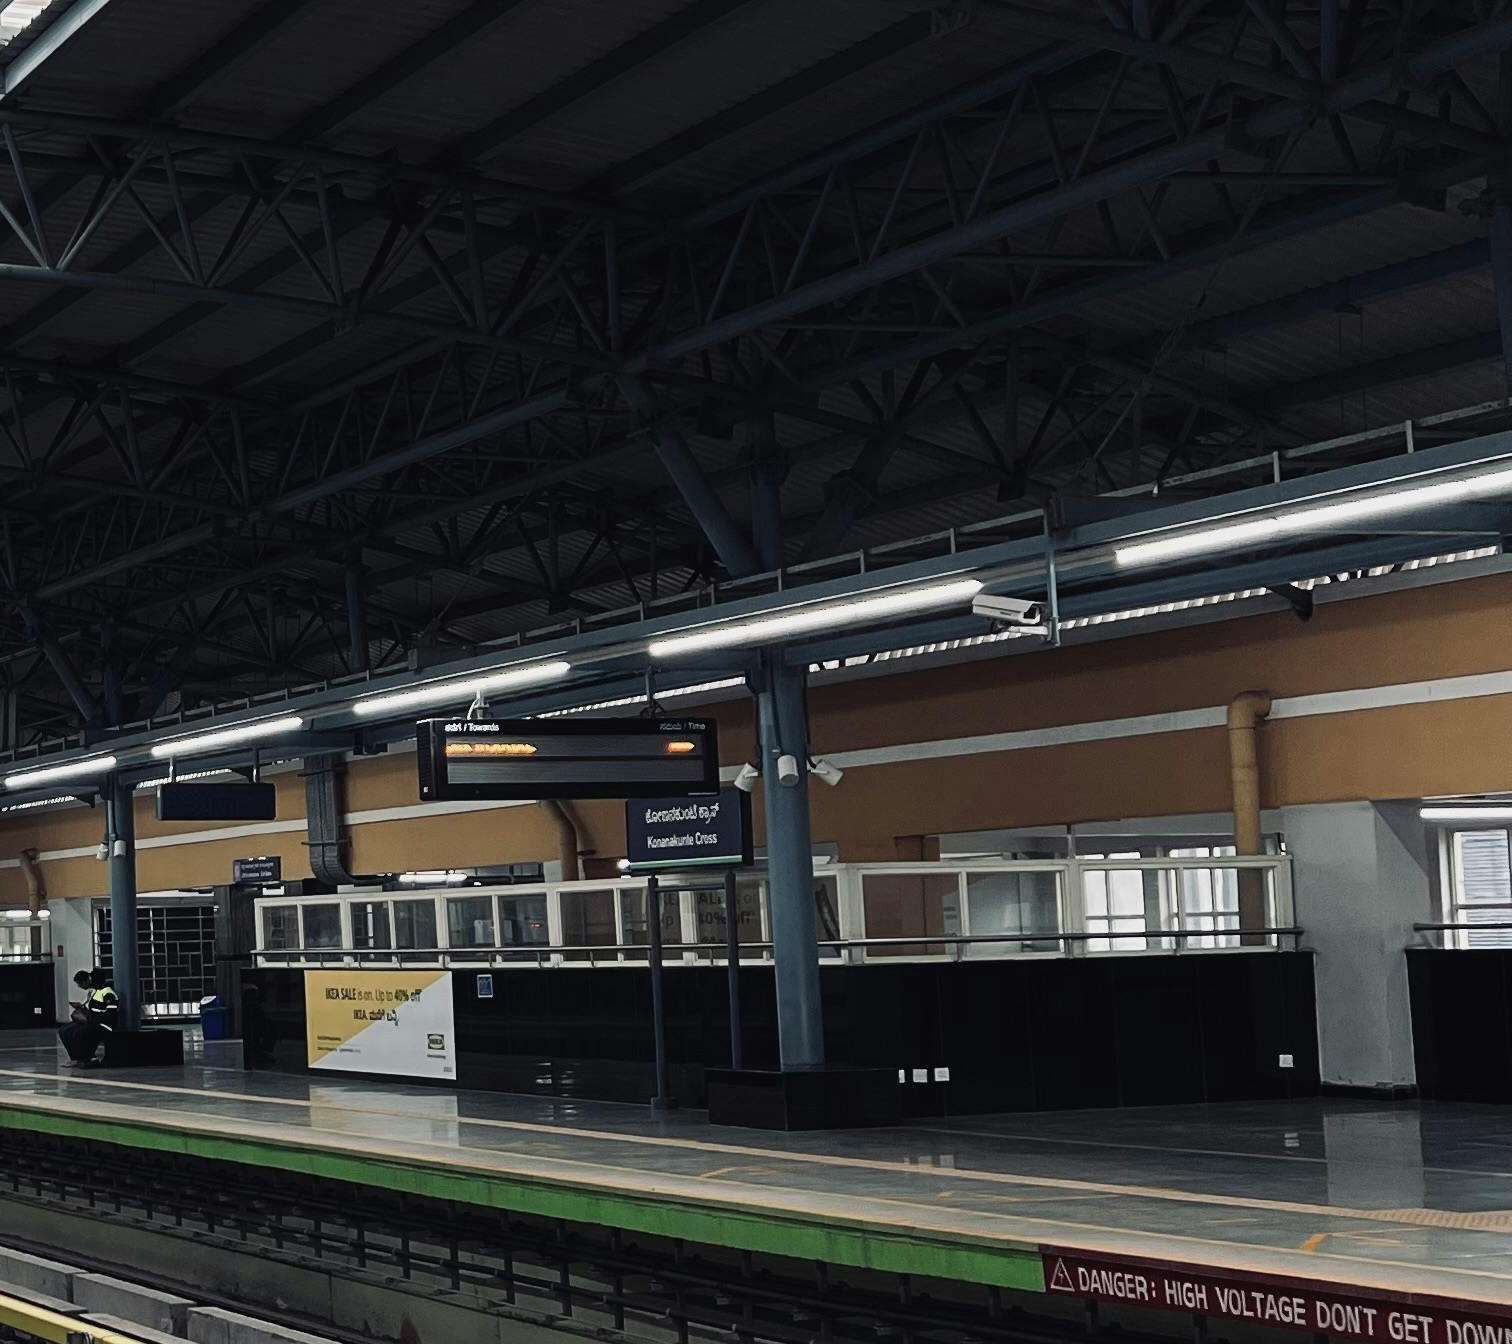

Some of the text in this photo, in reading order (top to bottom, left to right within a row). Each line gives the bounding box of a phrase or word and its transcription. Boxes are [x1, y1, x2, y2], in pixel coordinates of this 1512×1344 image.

[688, 722, 706, 731] Time
[695, 831, 718, 845] Cross
[325, 988, 339, 1000] IKEA
[341, 988, 357, 1001] SALE
[375, 989, 385, 1004] Up
[386, 991, 393, 1002] to
[394, 988, 409, 1002] 40%
[410, 988, 423, 1002] off
[1164, 1279, 1208, 1311] HIGH
[1214, 1286, 1307, 1326] VOLTAGE
[1316, 1300, 1377, 1337] DON'T
[1388, 1311, 1434, 1344] GET
